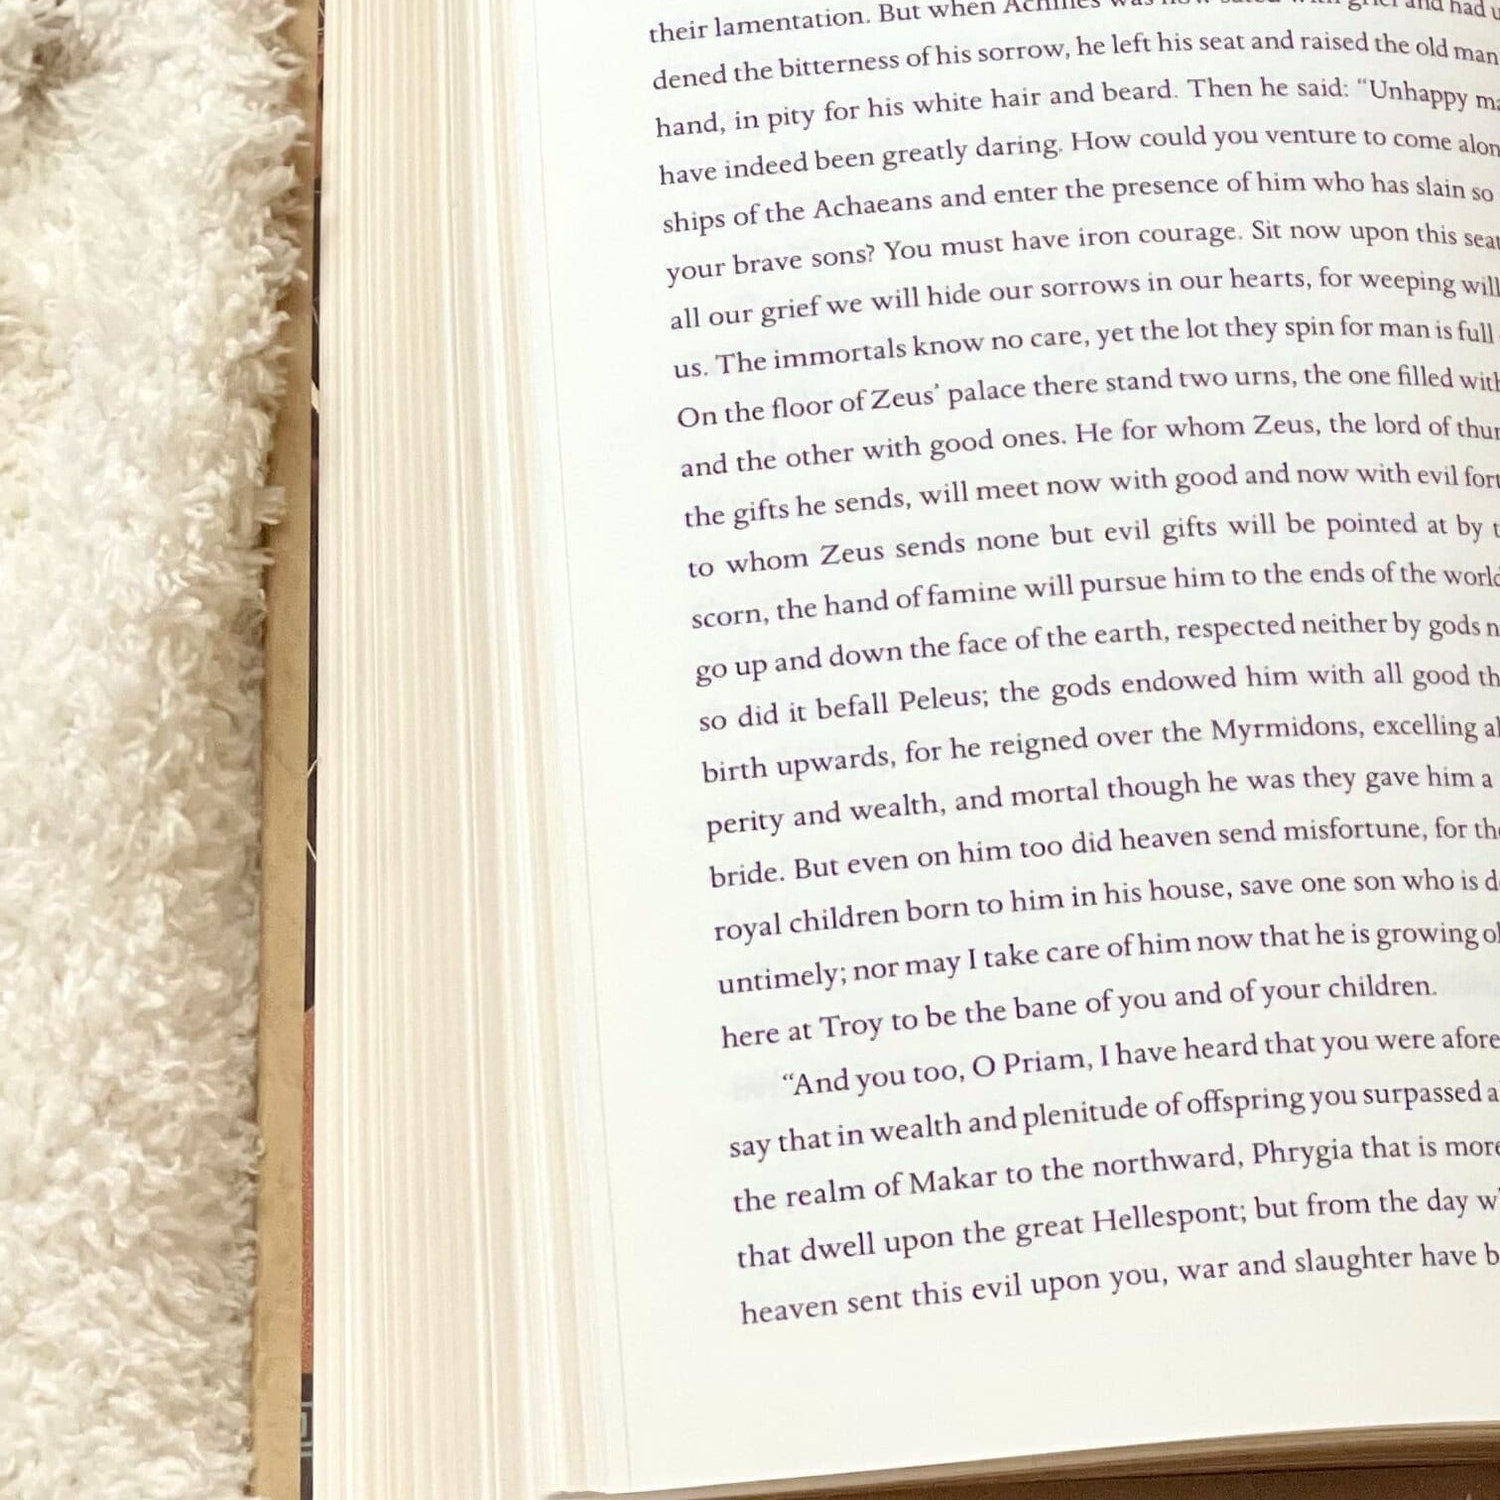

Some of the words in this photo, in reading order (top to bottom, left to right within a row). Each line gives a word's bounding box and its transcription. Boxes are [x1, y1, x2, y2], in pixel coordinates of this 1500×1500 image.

[648, 20, 709, 44] their
[713, 8, 871, 38] lamentation.
[877, 3, 922, 23] But
[701, 755, 769, 784] birth
[776, 744, 896, 782] upwards,
[904, 739, 943, 764] for
[948, 736, 982, 760] he
[989, 725, 1089, 761] reigned
[1096, 729, 1154, 748] over
[1161, 719, 1202, 744] the
[1210, 713, 1365, 747] Myrmidons,
[1372, 712, 1479, 744] excelling
[740, 1299, 839, 1325] heaven
[847, 1290, 903, 1314] sent
[911, 1280, 963, 1307] this
[971, 1271, 1023, 1301] evil
[1030, 1272, 1101, 1302] upon
[1108, 1267, 1168, 1296] you,
[1176, 1261, 1230, 1282] war
[1237, 1249, 1287, 1277] and
[1294, 1244, 1414, 1278] slaughter
[1419, 1242, 1478, 1268] have
